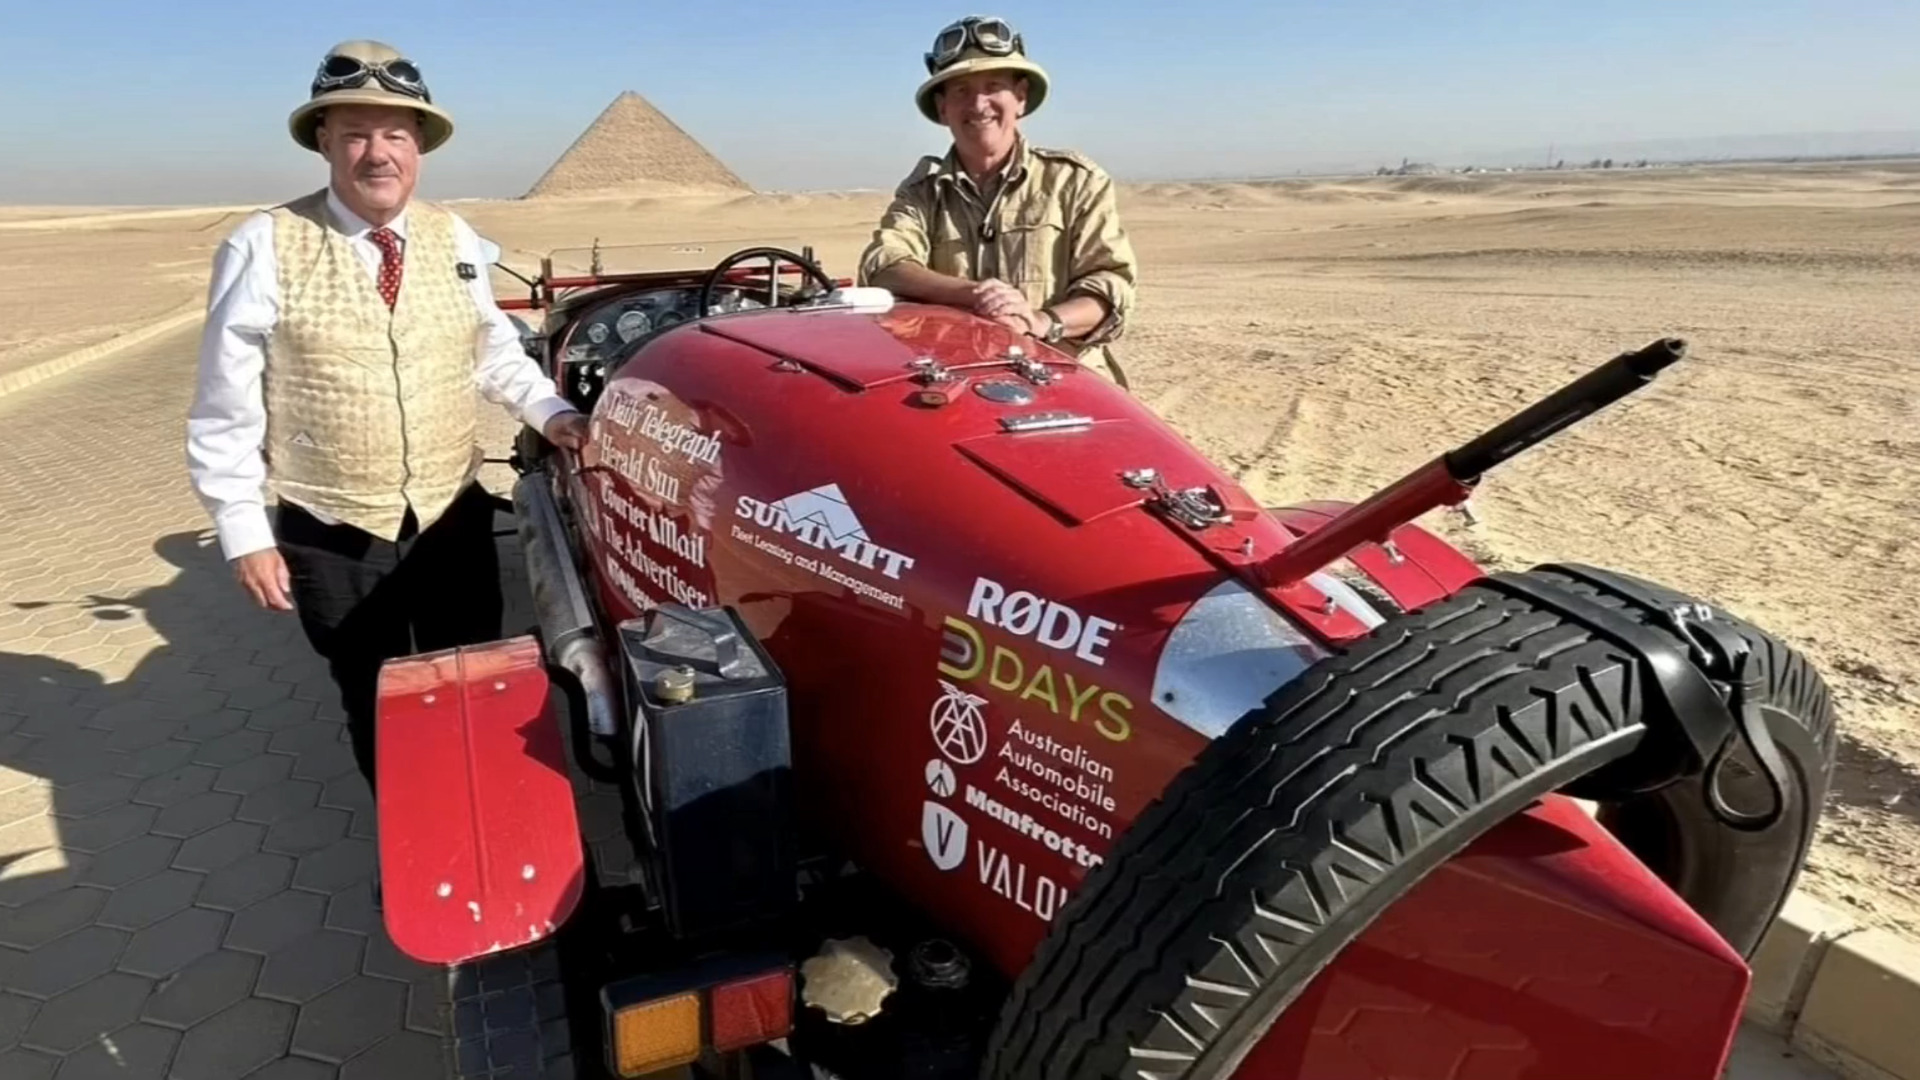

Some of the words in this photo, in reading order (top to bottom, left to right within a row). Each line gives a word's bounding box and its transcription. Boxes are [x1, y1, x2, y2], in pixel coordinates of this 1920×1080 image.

[607, 392, 642, 435] Daily
[640, 404, 722, 464] Telegraph
[601, 433, 644, 484] Herald
[645, 457, 679, 503] Sun
[601, 479, 648, 532] Courier
[659, 514, 704, 569] Mail
[602, 512, 624, 556] The
[624, 531, 707, 610] Advertiser
[735, 496, 915, 579] SUMMIT
[731, 525, 754, 545] Fleet
[755, 534, 793, 564] Leasing
[795, 555, 818, 572] and
[819, 562, 904, 609] Management
[989, 645, 1133, 741] DAYS
[998, 741, 1116, 812] Automobile
[1007, 718, 1113, 782] Australian
[995, 767, 1112, 839] Association
